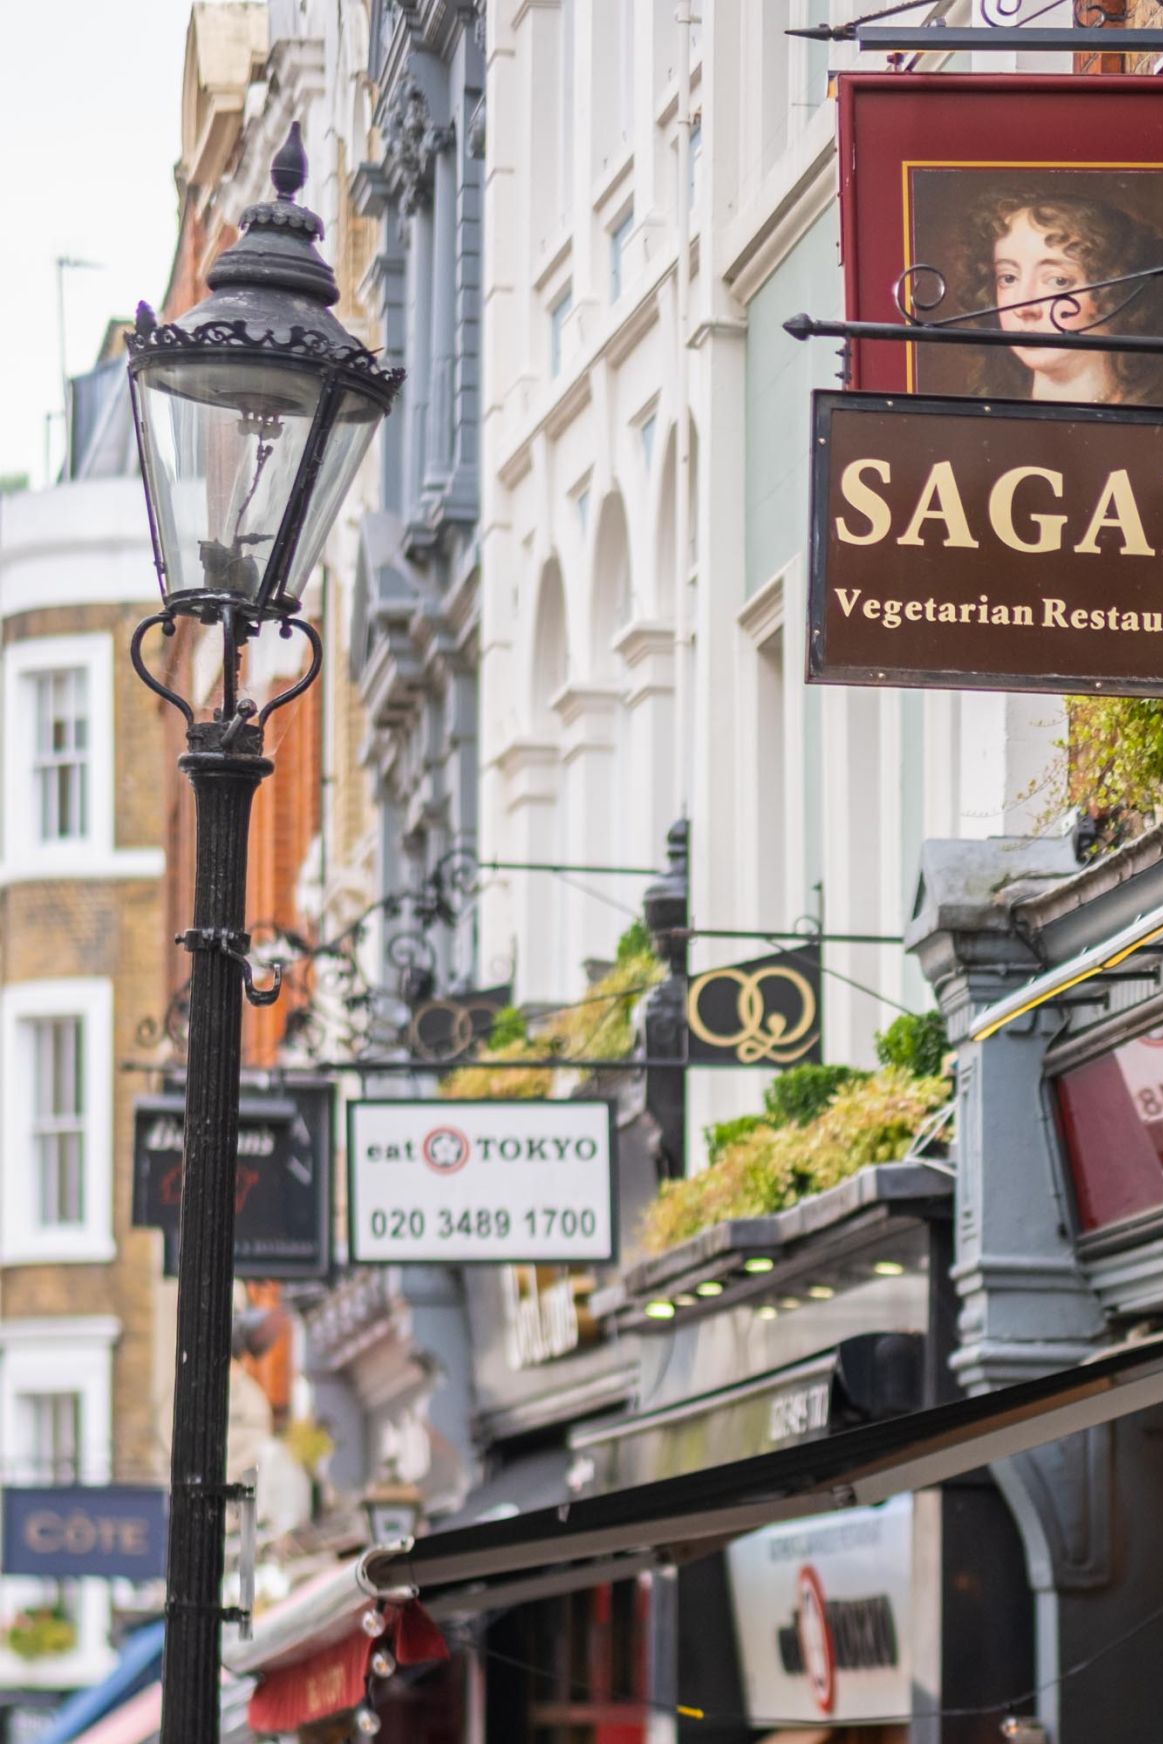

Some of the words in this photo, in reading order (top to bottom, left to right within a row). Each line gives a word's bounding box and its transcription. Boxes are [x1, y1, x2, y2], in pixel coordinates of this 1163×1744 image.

[834, 587, 1034, 629] Vegetarian
[366, 1137, 415, 1162] eat
[476, 1137, 599, 1162] TOKYO
[371, 1208, 425, 1240] 020
[437, 1208, 512, 1240] 3489
[525, 1208, 596, 1240] 1700
